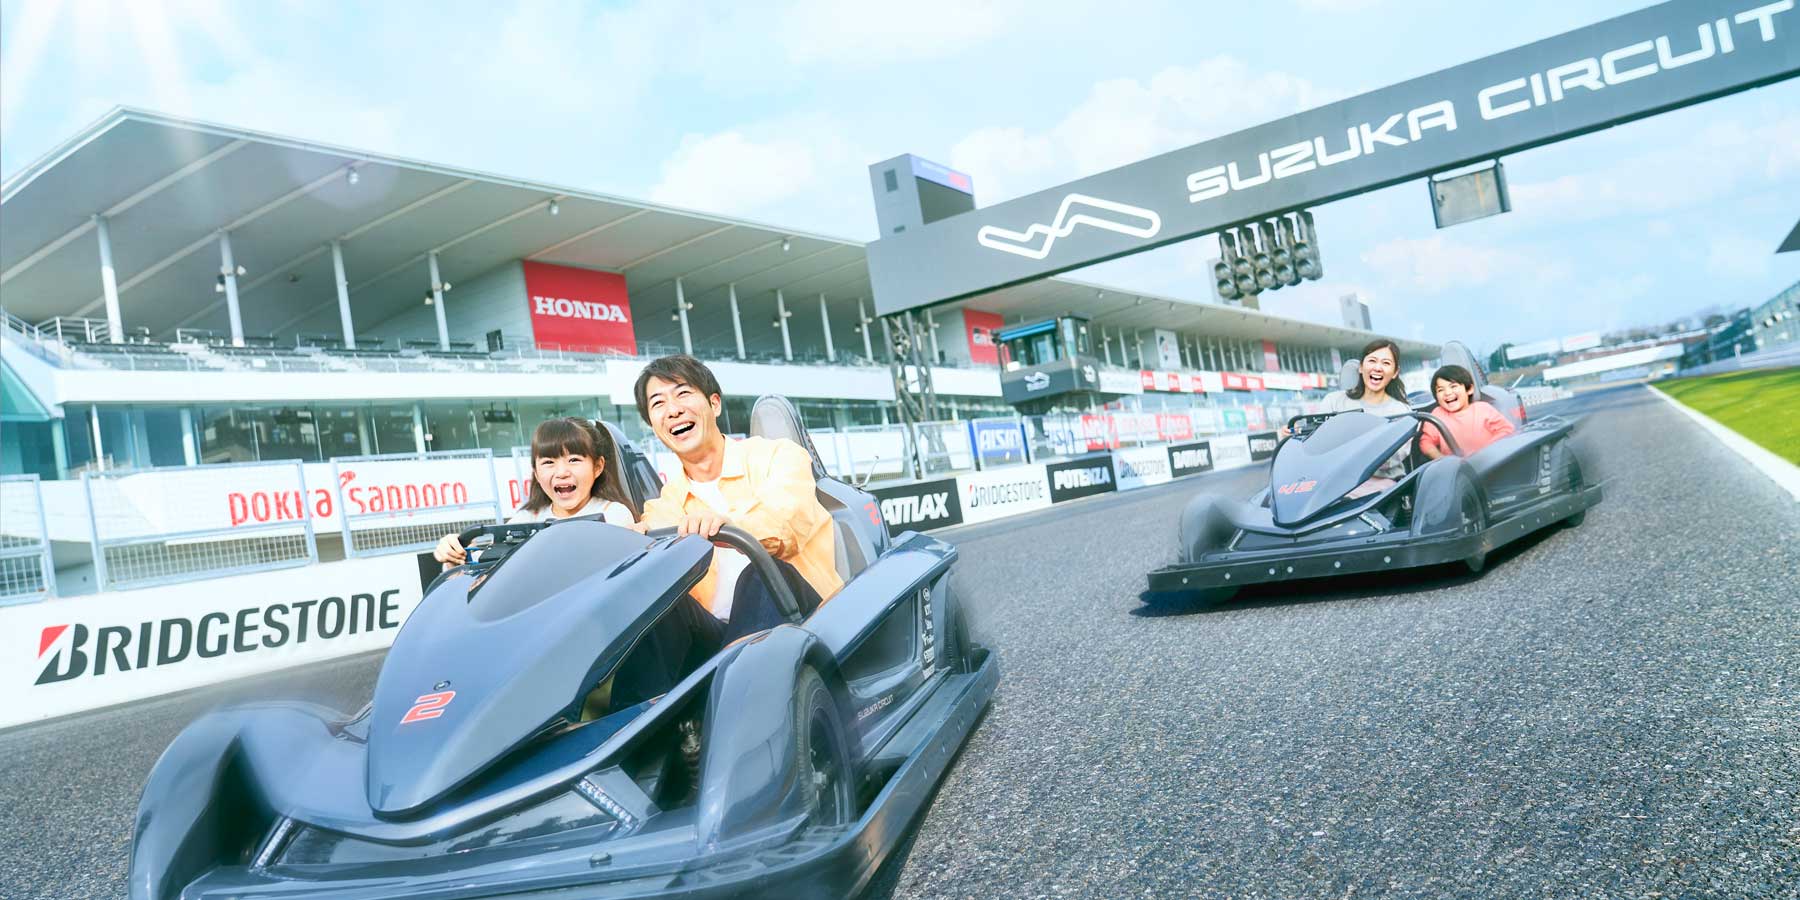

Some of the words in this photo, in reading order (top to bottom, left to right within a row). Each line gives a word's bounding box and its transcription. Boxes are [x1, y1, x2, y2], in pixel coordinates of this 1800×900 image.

[1186, 100, 1457, 203] SUZUKA
[1477, 0, 1794, 121] CIRCUIT
[533, 295, 628, 323] HONDA
[969, 480, 1044, 508] BRIDGESTONE
[1053, 466, 1111, 491] POTENZA
[34, 589, 400, 686] BRIDGESTONE
[400, 690, 457, 724] 2
